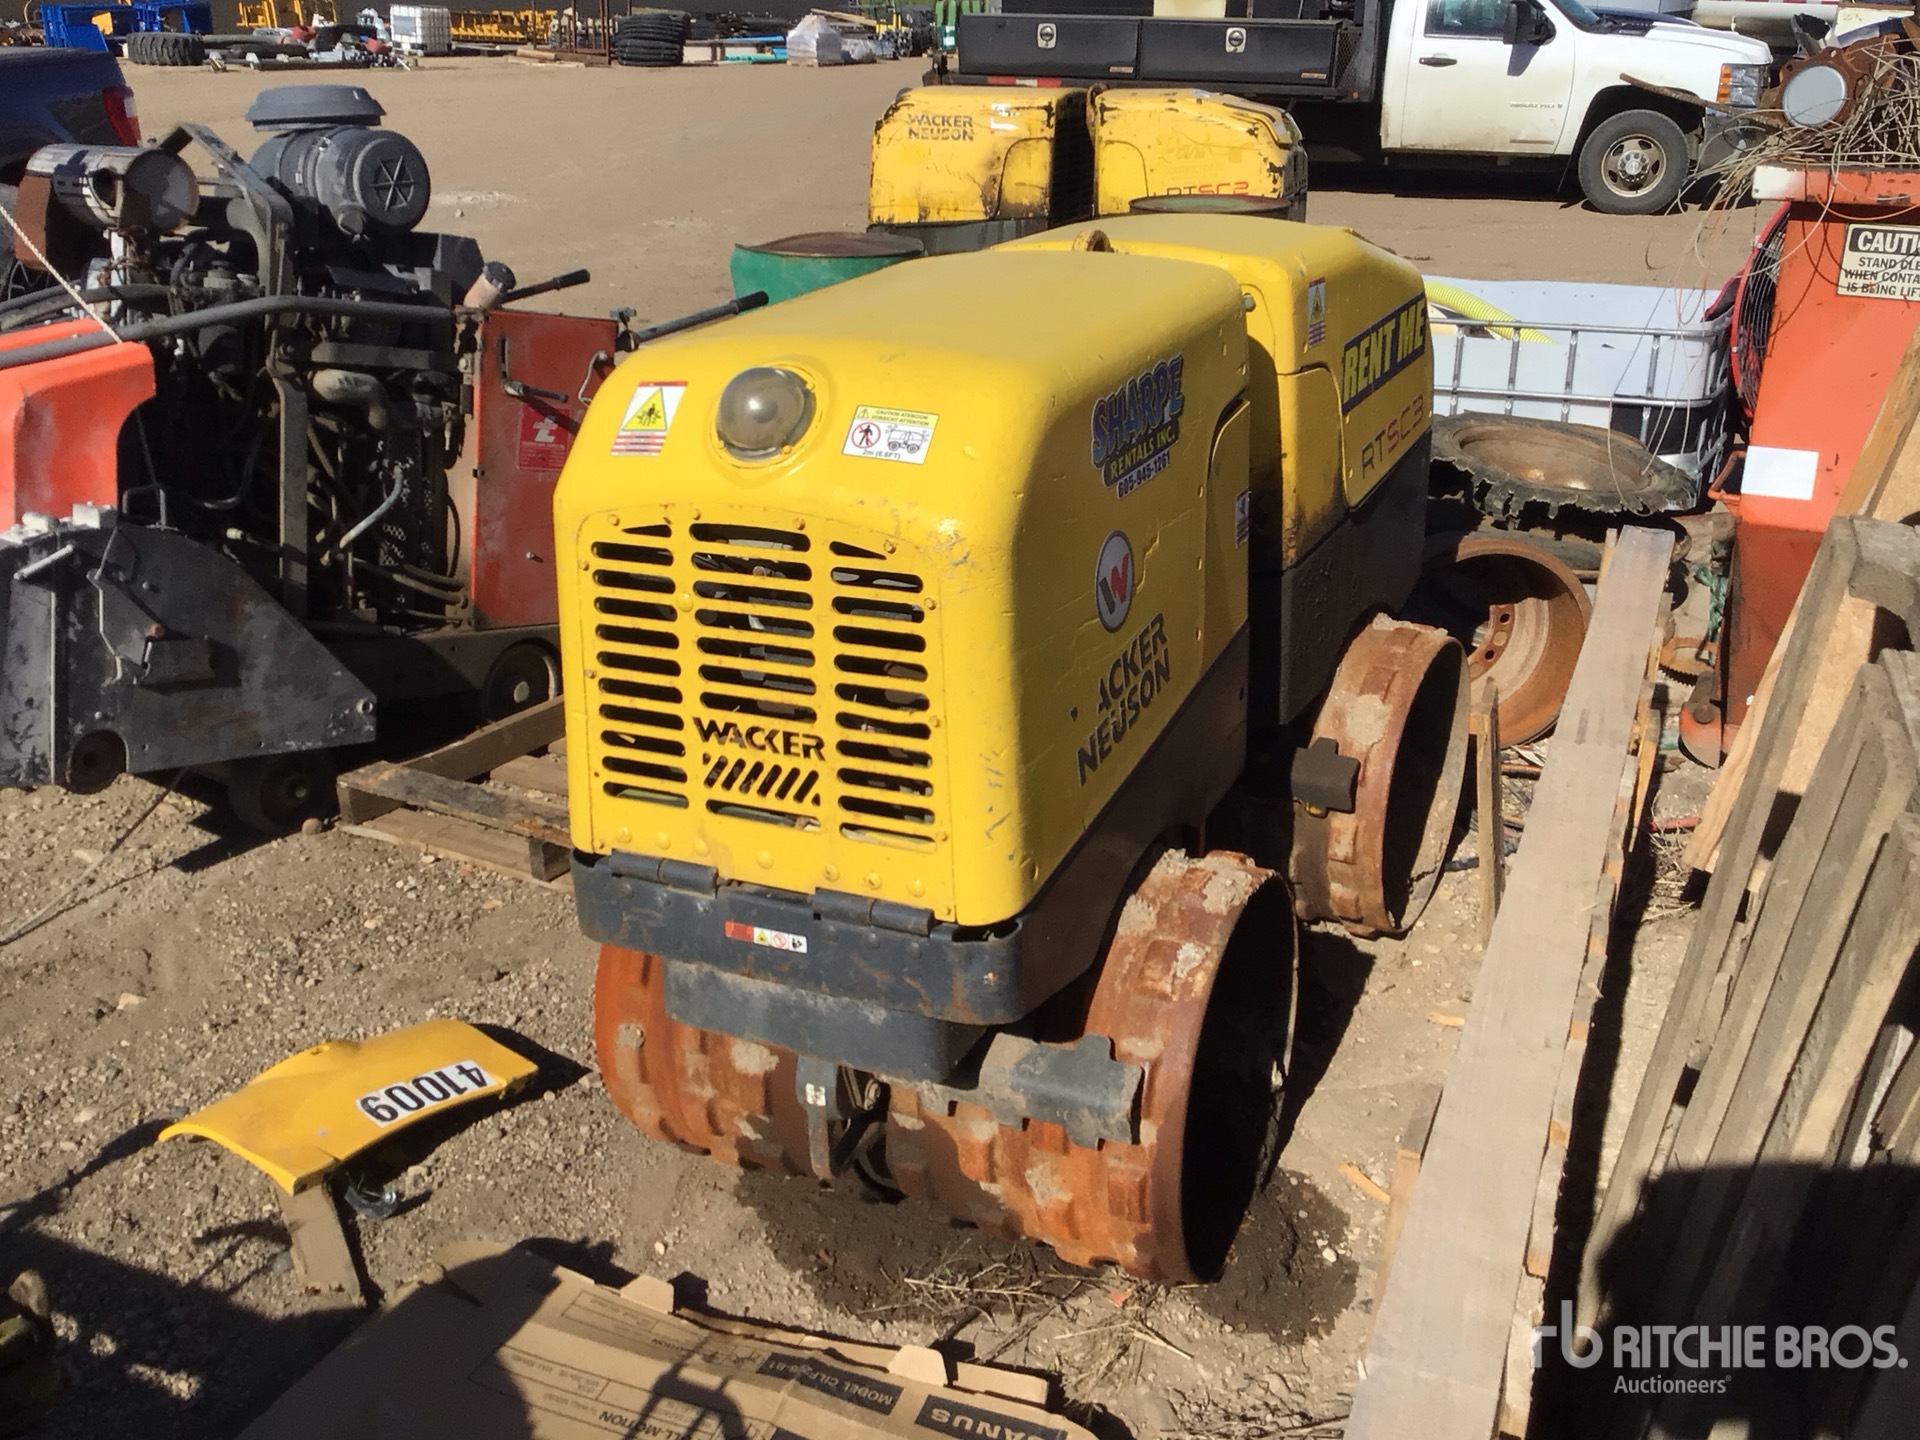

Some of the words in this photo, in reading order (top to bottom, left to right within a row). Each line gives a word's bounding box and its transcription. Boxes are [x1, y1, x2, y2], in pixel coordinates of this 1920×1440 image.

[908, 114, 973, 128] WACKER
[908, 127, 974, 141] NEUSON
[1857, 230, 1920, 255] CAUTI
[1844, 269, 1878, 280] WHEN
[1858, 257, 1898, 269] STAND
[1846, 282, 1858, 292] IS
[1343, 317, 1396, 404] RENT
[1397, 297, 1426, 363] ME
[1092, 353, 1184, 469] SHARPE
[1362, 393, 1424, 480] RTSC3
[1110, 436, 1154, 480] RENTALS
[692, 716, 826, 762] WACKER
[360, 1064, 488, 1122] 41009
[844, 1381, 894, 1406] MODEL
